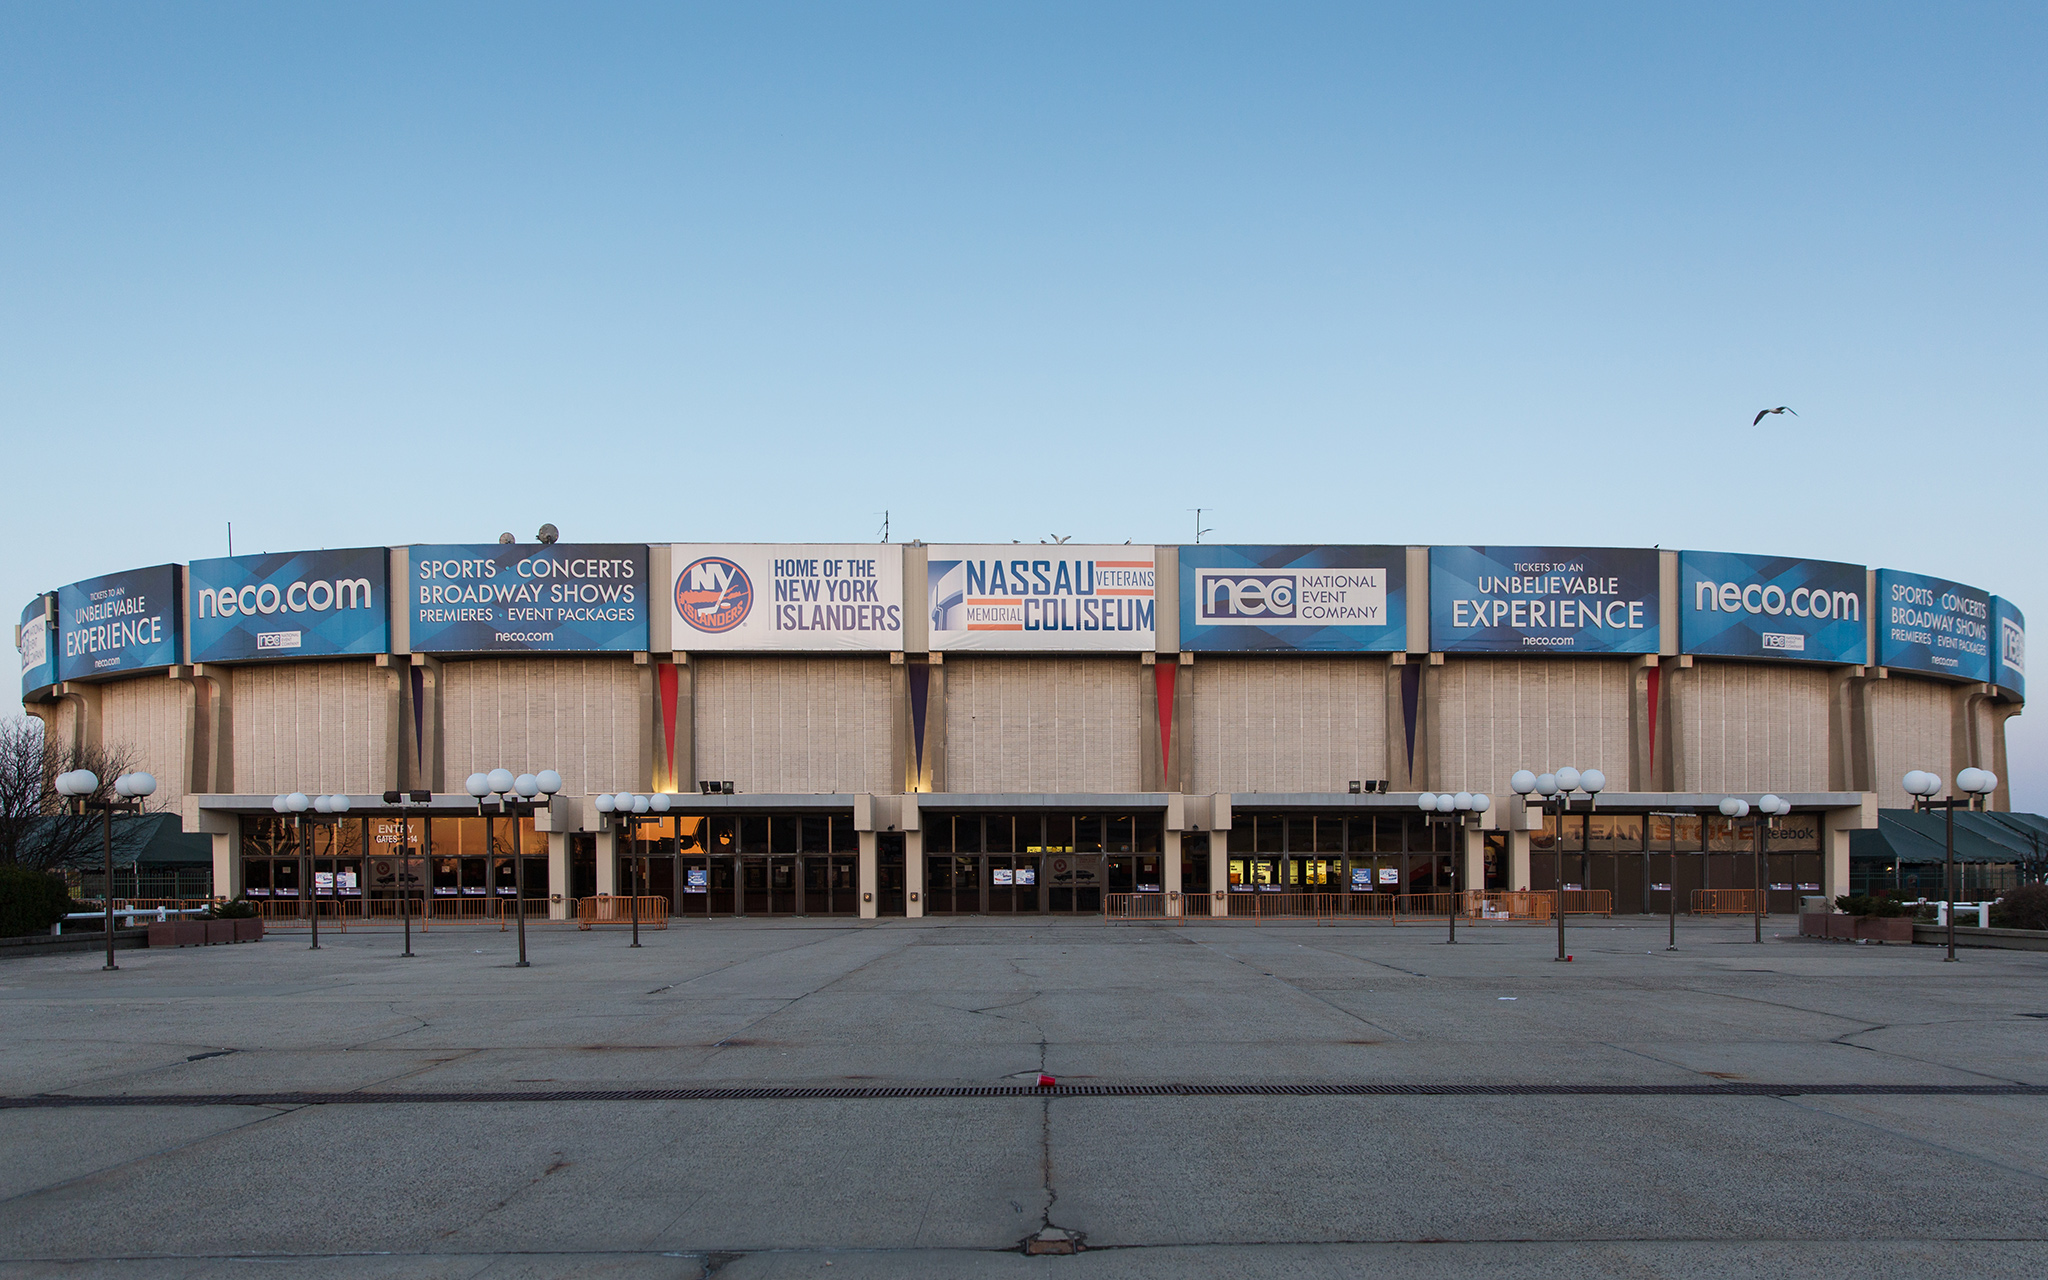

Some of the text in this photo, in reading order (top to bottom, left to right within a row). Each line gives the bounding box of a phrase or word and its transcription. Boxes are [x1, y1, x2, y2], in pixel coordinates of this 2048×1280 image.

[419, 558, 634, 580] SPORTS CONCERTS
[774, 559, 875, 577] HOME OF THE
[1513, 562, 1584, 572] TICKETS TO AN
[966, 560, 1155, 596] NASSAU VETERANS
[1302, 575, 1377, 588] NATIONAL
[1478, 576, 1619, 595] UNBELIEVABLE
[90, 587, 125, 602] TICKETS TO AN
[198, 577, 372, 618] neco.com
[420, 584, 634, 604] BROADWAY SHOWS
[775, 579, 879, 602] NEW YORK
[1302, 591, 1346, 603] EVENT
[1695, 581, 1859, 621] neco.com
[75, 596, 146, 625] UNBELIEVABLE
[1891, 584, 1987, 619] SPORTS CONCERTS
[420, 608, 635, 623] PREMIERES EVENT PACKAGES
[684, 600, 744, 627] ISLANDERS
[776, 604, 901, 632] ISLANDERS
[967, 598, 1155, 632] MEMORIAL COLISEUM
[1302, 606, 1378, 619] COMPANY
[1452, 600, 1644, 629] EXPERIENCE
[1891, 606, 1987, 640] BROADWAY SHOWS
[66, 616, 162, 658] EXPERIENCE
[495, 631, 554, 642] neco.com
[1522, 635, 1574, 646] neco.com
[1891, 628, 1987, 656] PREMIERES EVENT PACKAGES
[94, 656, 121, 669] neco.com
[1931, 655, 1959, 667] neco.com
[376, 835, 398, 843] GATES
